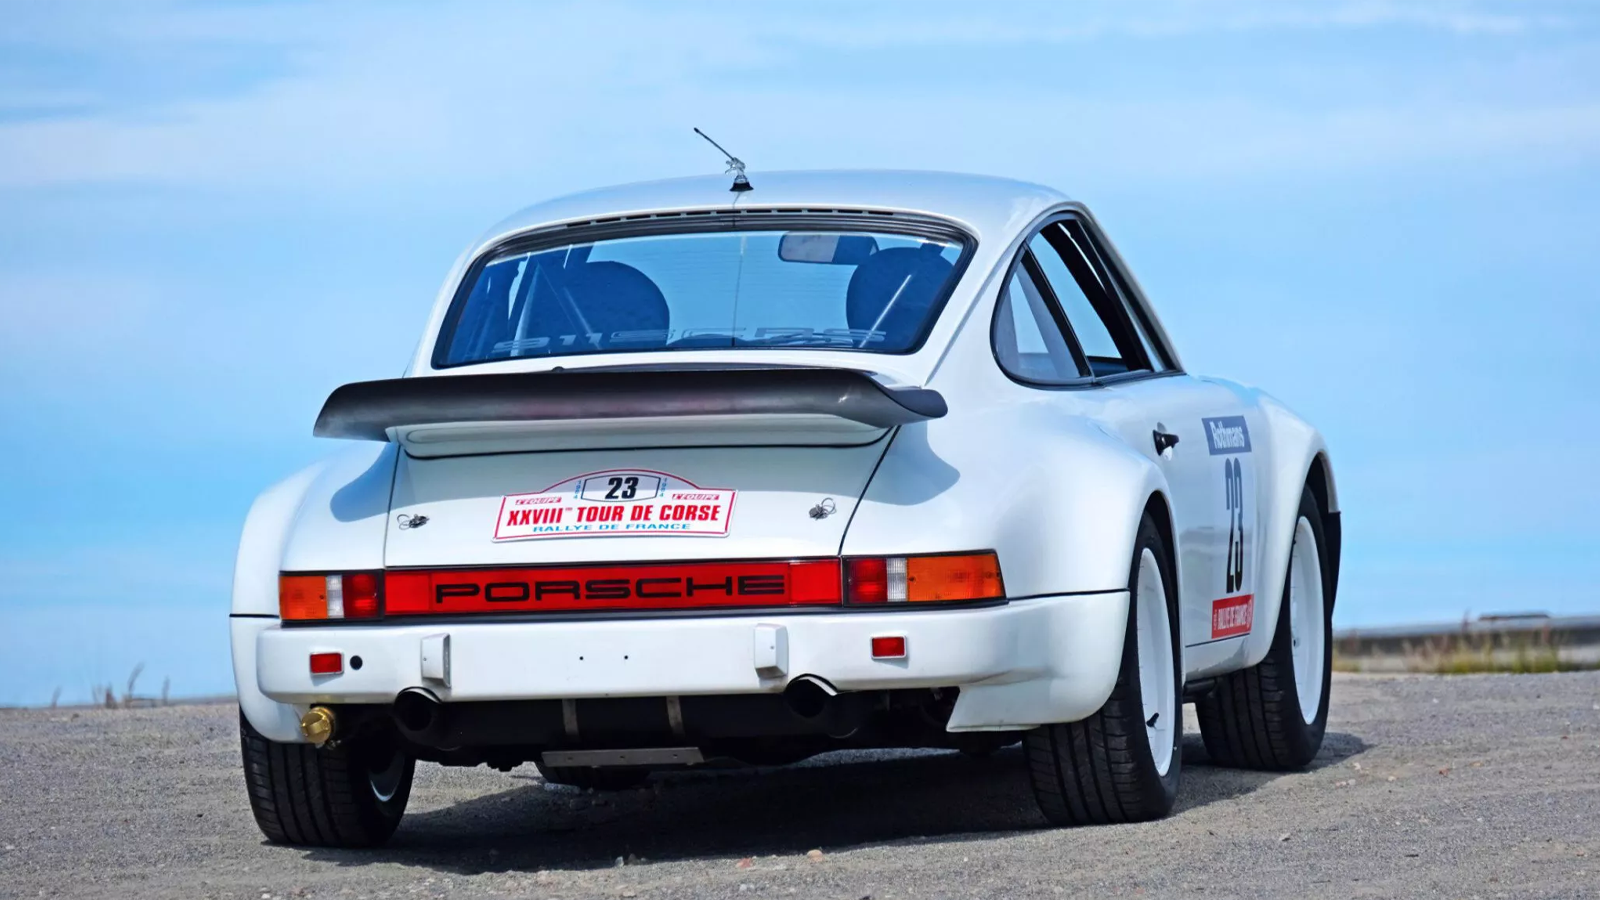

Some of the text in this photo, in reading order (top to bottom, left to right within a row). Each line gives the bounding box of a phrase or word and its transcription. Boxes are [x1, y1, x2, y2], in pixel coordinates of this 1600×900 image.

[604, 477, 639, 499] 23
[577, 505, 624, 522] TOUR
[630, 505, 653, 521] DE
[659, 504, 721, 521] CORSE
[1225, 457, 1243, 593] 23
[436, 574, 785, 604] PORSCHE
